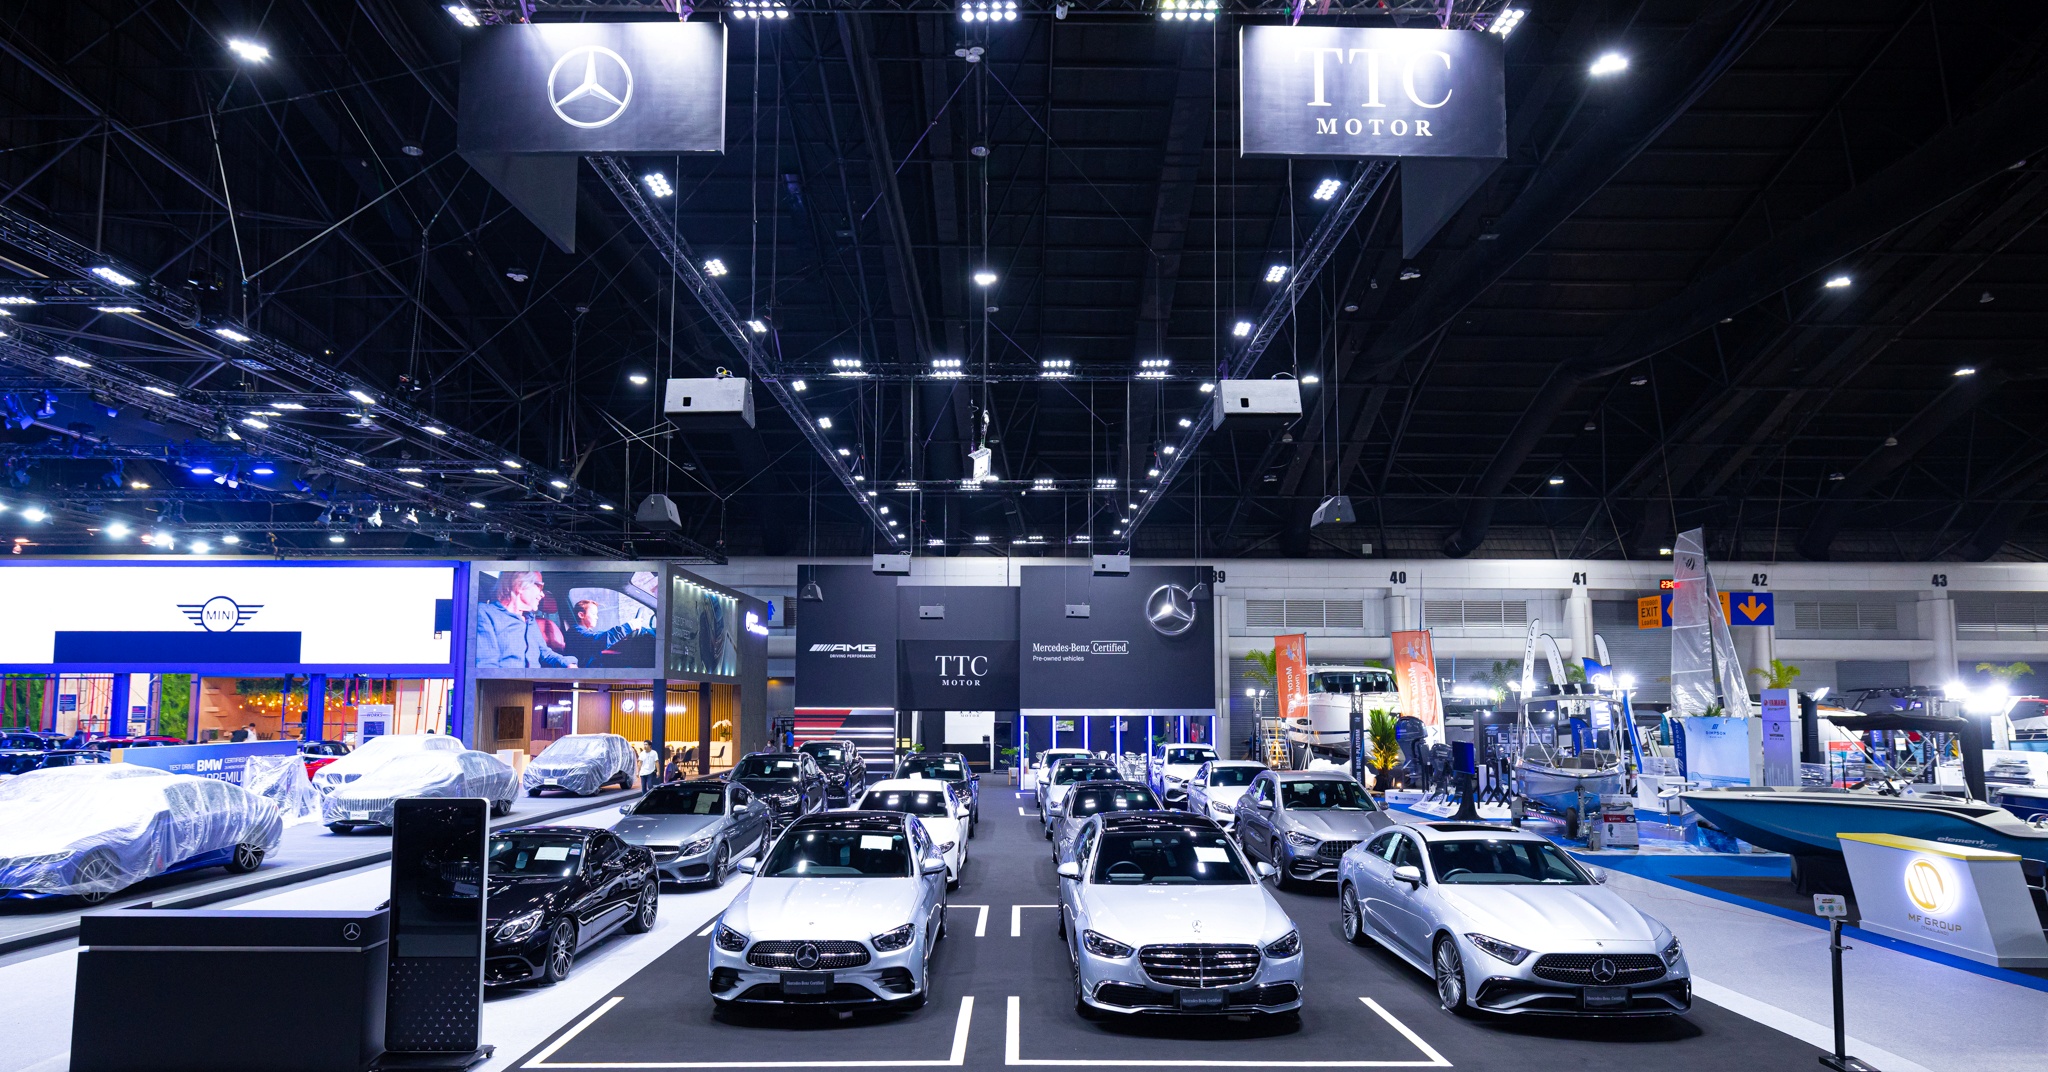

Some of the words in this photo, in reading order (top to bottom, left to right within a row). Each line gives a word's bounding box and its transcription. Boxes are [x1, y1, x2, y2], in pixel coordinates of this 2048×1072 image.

[1295, 48, 1453, 109] TTC
[1316, 118, 1433, 137] MOTOR
[1389, 571, 1407, 584] 40
[1572, 572, 1587, 585] 41
[1751, 573, 1768, 586] 42
[1931, 574, 1948, 587] 43
[206, 610, 234, 620] MINI
[1641, 606, 1659, 618] EXIT
[1641, 618, 1659, 627] Loading
[830, 643, 877, 652] AMG
[1032, 642, 1090, 653] Mercedes-Benz
[1092, 642, 1127, 653] Certified
[934, 655, 988, 677] TTC
[941, 679, 981, 687] MOTOR
[196, 758, 223, 772] BMW
[1937, 836, 1985, 845] element
[1908, 913, 1921, 923] MF
[1924, 916, 1963, 932] GROUP
